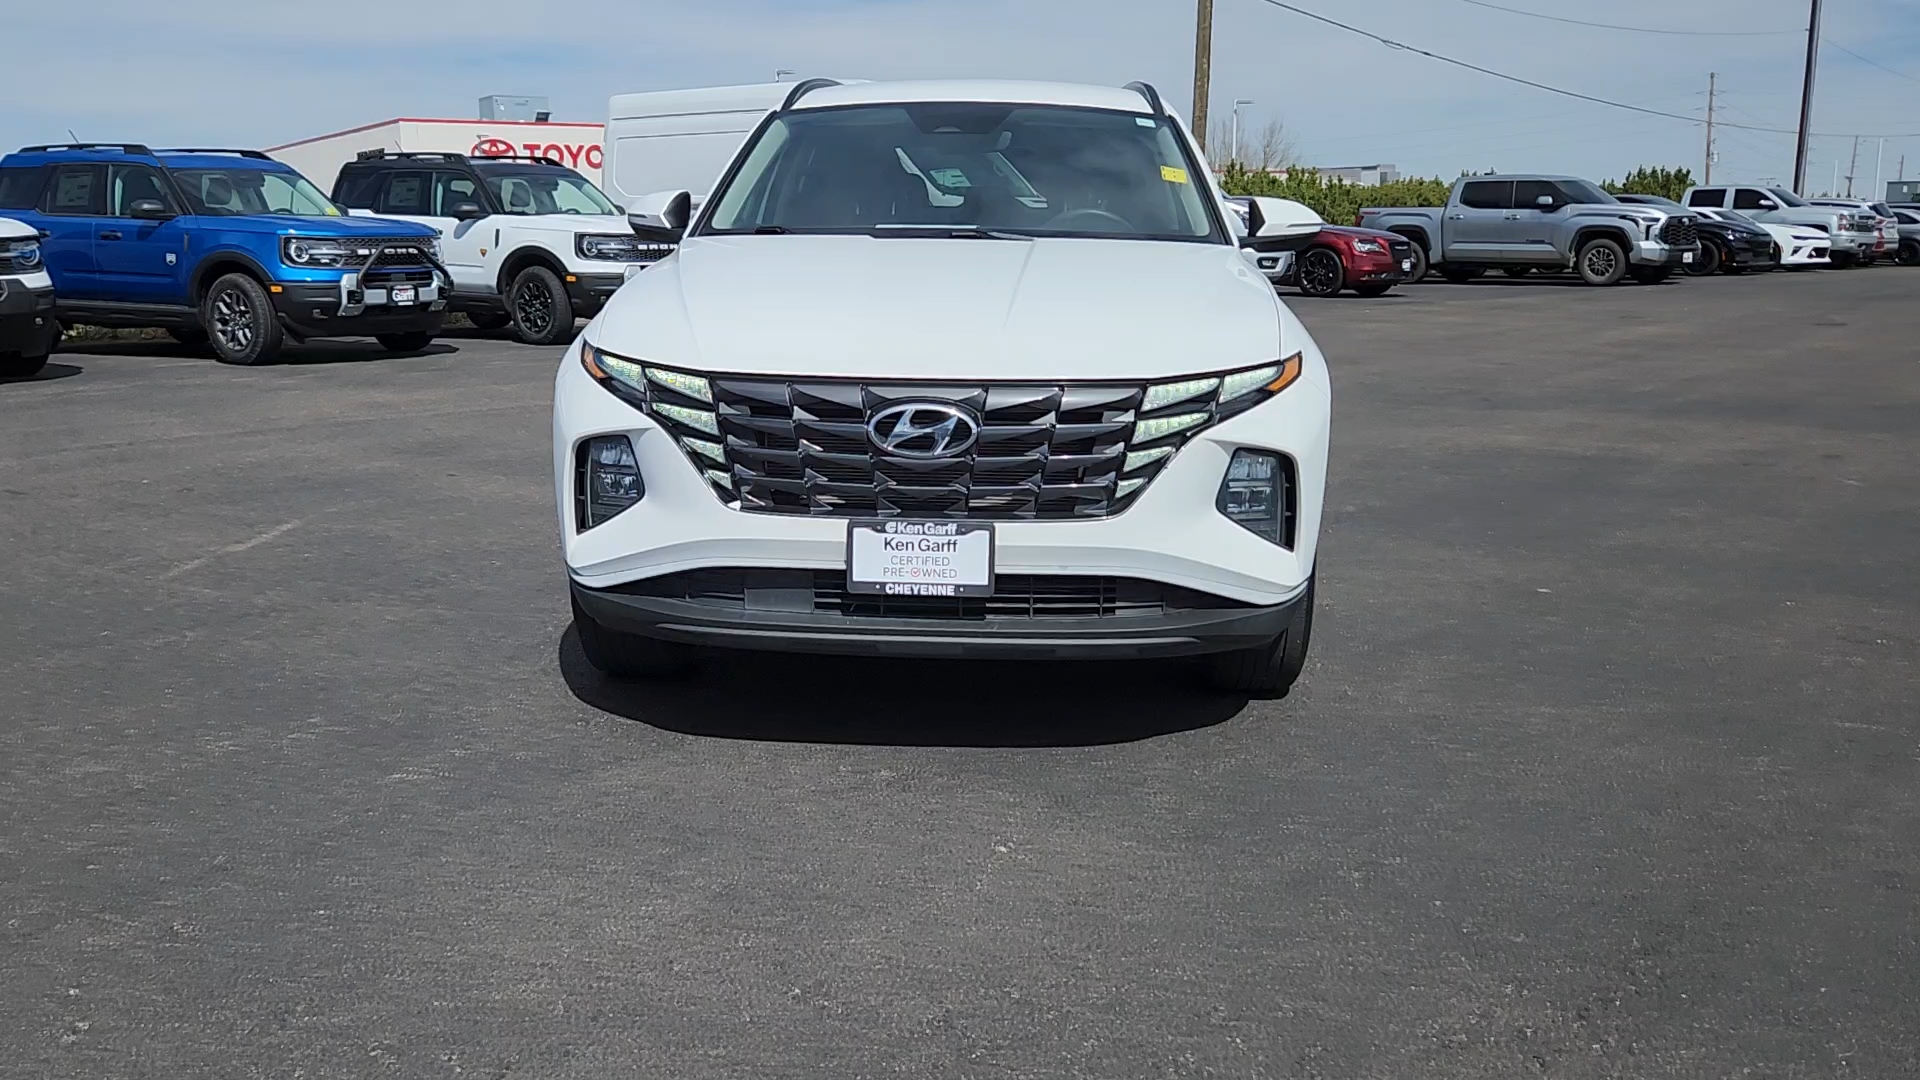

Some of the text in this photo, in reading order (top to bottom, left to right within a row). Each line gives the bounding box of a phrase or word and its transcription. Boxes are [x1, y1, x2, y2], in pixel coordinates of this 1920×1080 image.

[897, 521, 957, 535] Ken Garff
[884, 537, 958, 553] Ken Garff
[890, 555, 950, 567] CERTIFIED
[885, 583, 955, 596] CHEYENNE
